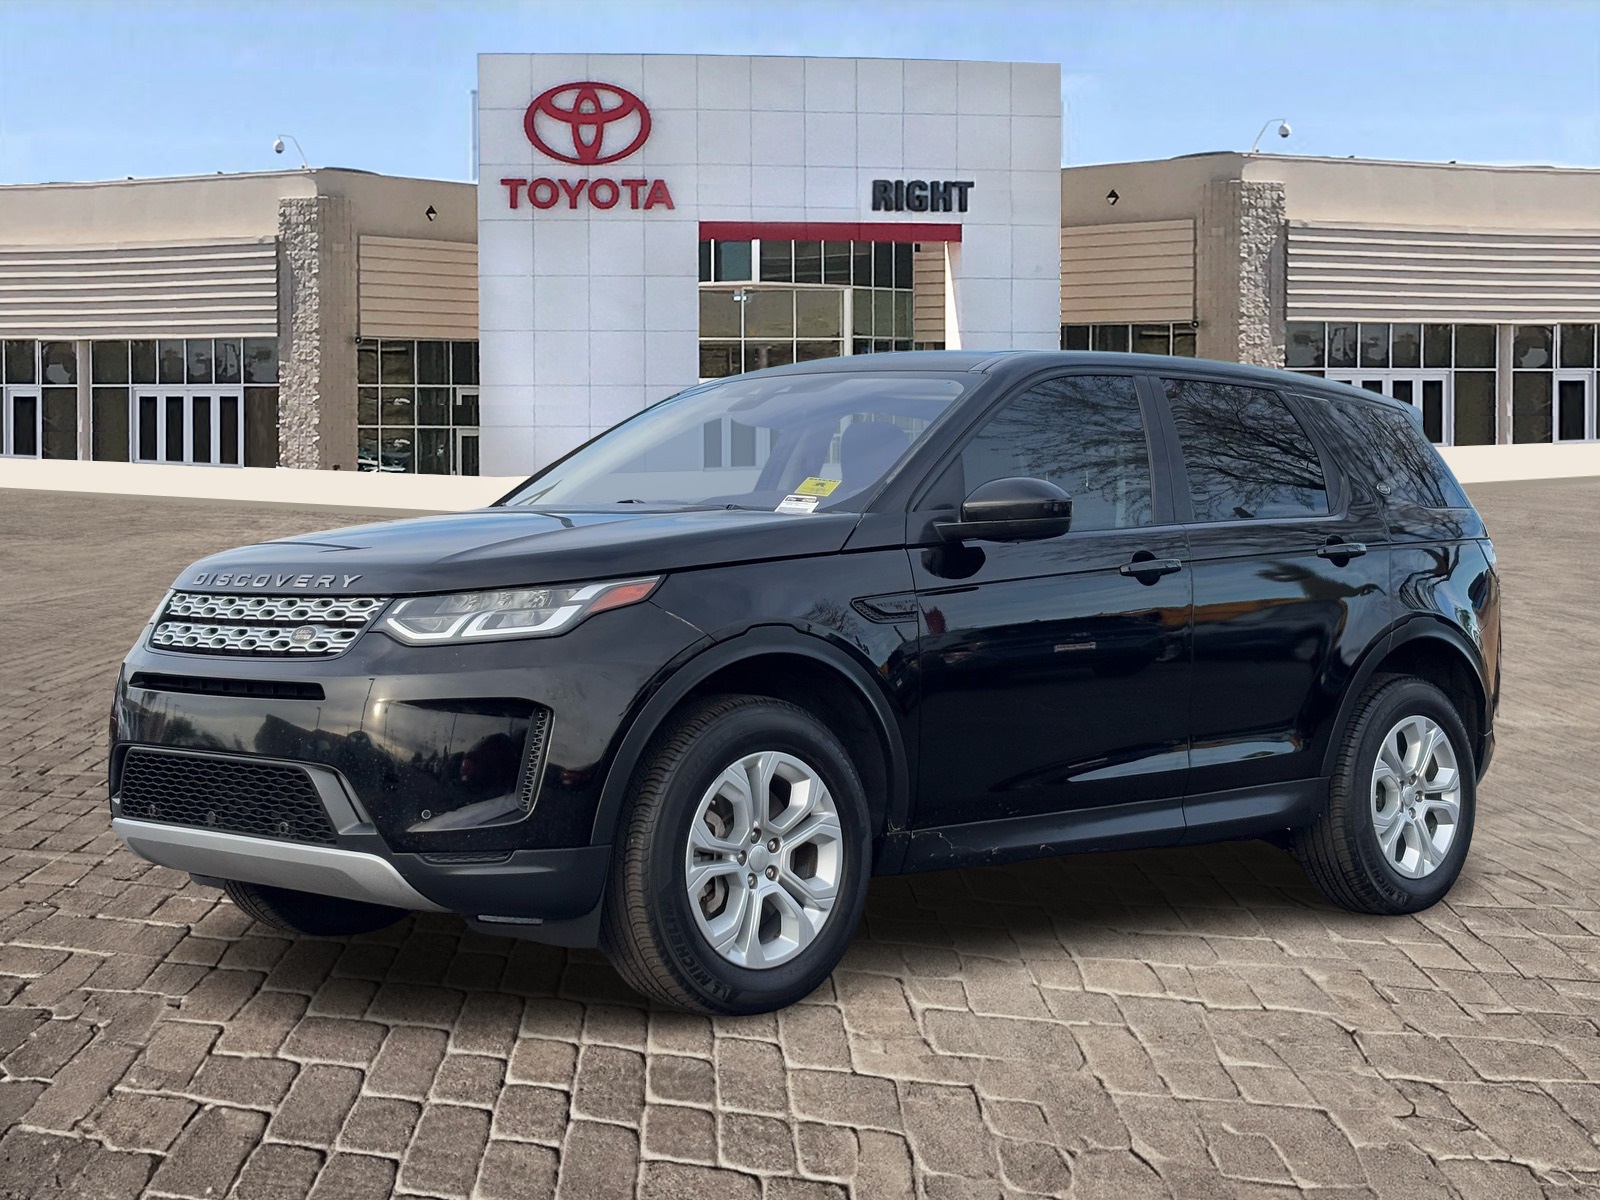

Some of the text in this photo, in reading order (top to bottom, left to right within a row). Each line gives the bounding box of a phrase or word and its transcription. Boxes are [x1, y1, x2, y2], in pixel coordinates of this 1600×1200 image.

[501, 178, 675, 210] TOYOTA
[872, 179, 975, 212] RIGHT
[192, 573, 362, 588] DISCOVERY
